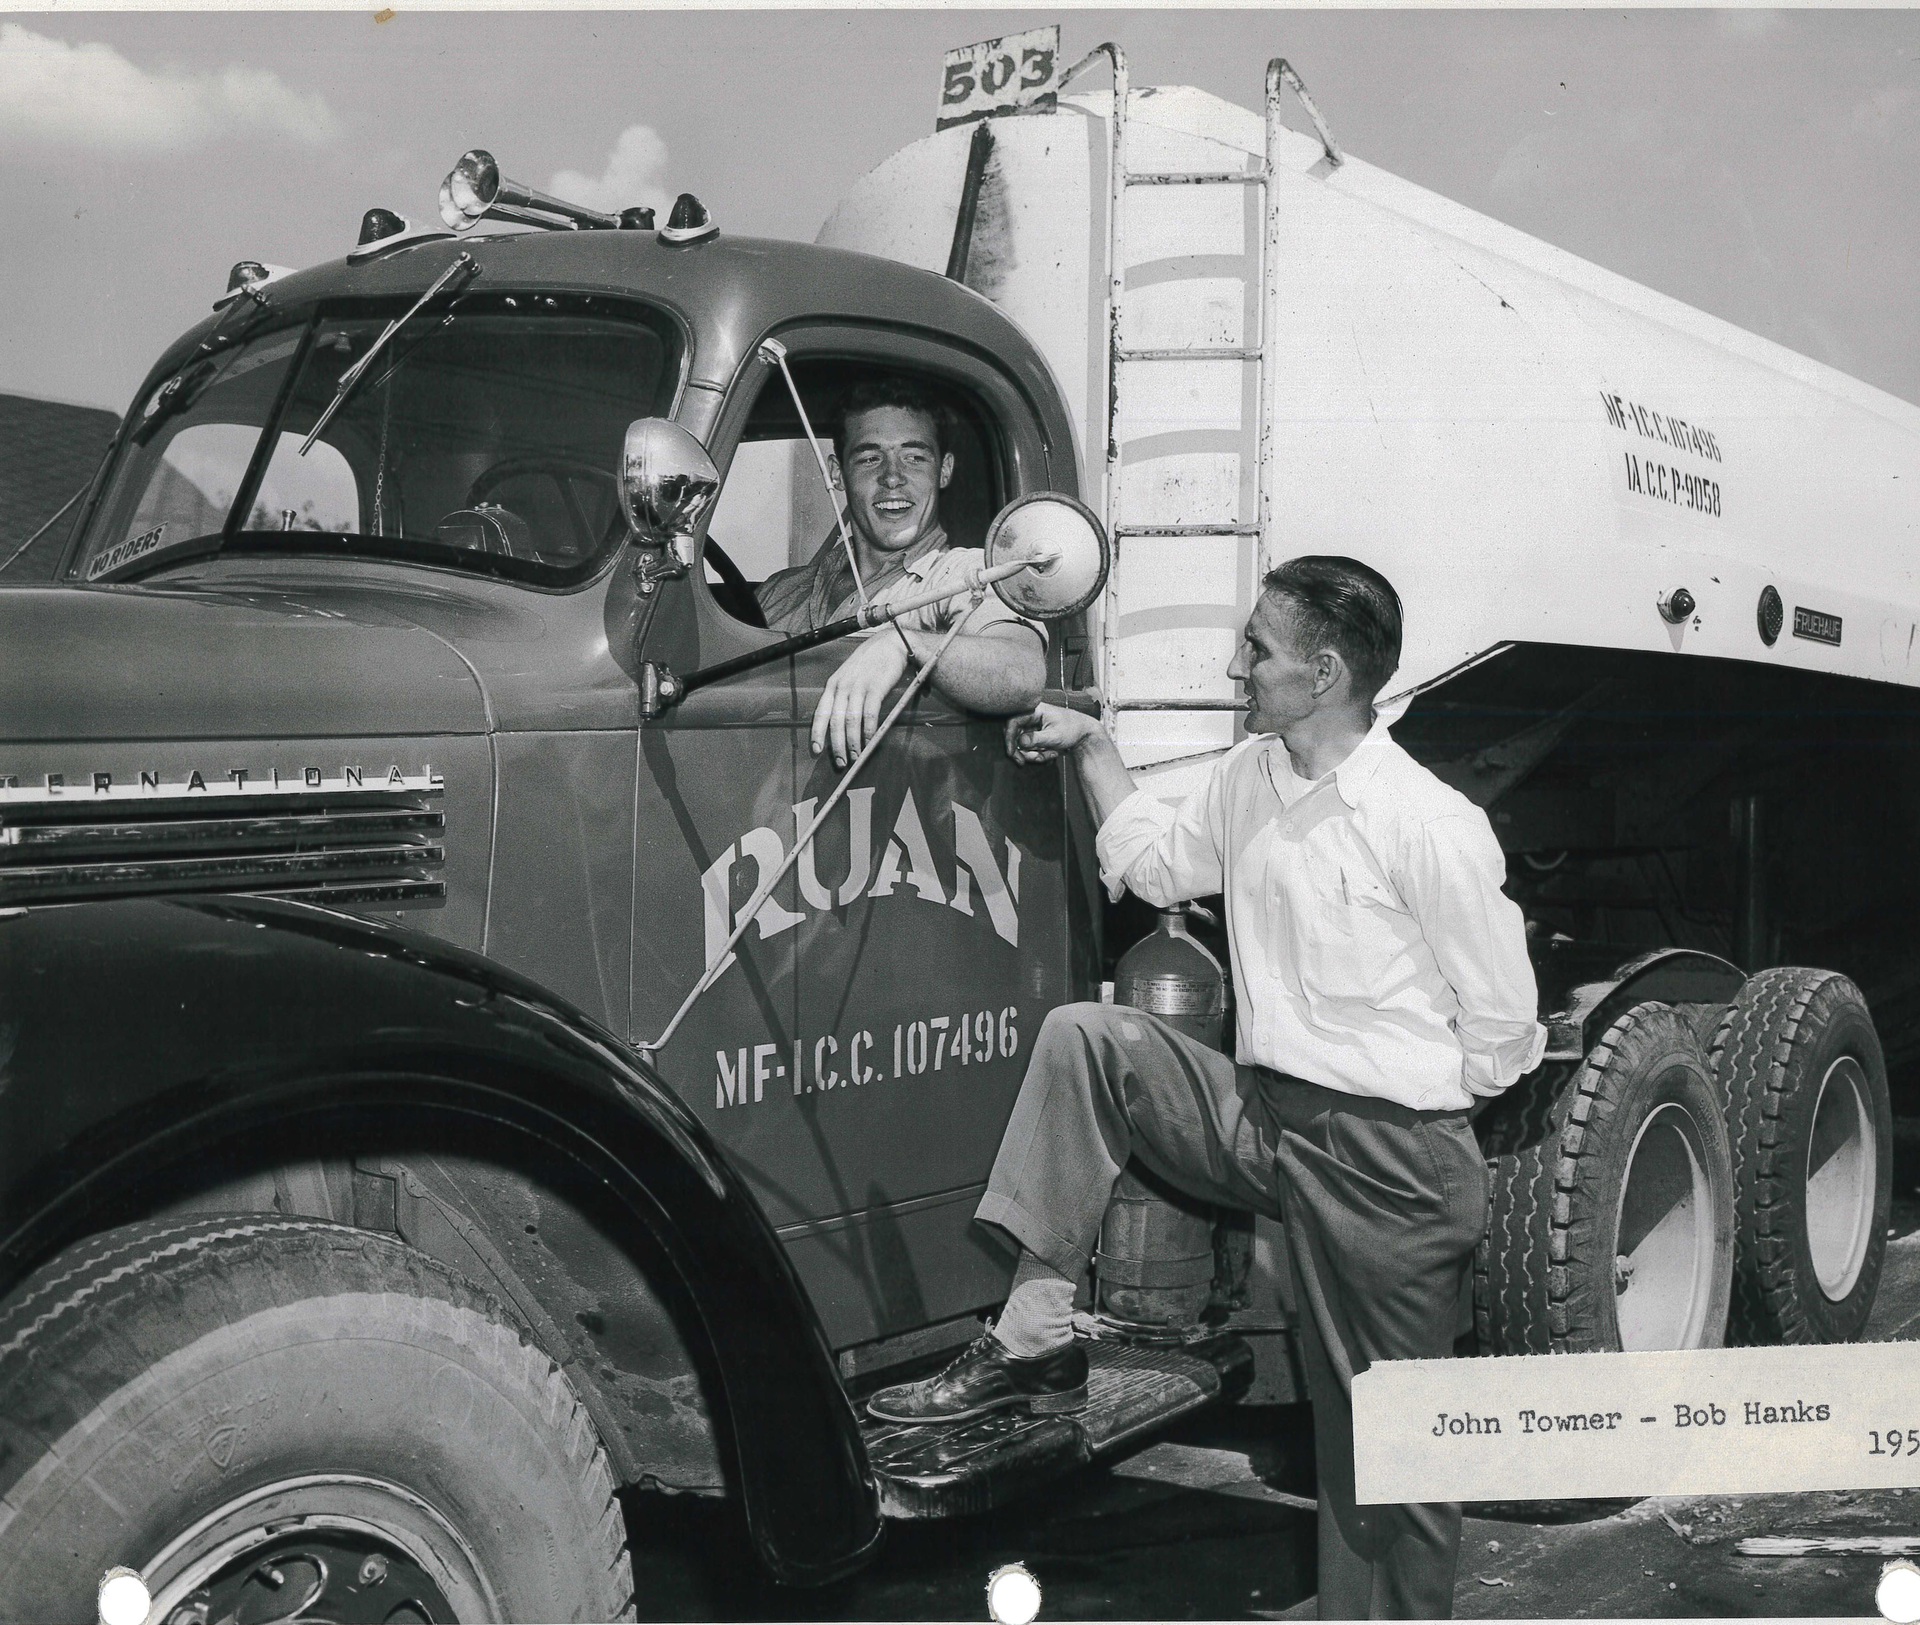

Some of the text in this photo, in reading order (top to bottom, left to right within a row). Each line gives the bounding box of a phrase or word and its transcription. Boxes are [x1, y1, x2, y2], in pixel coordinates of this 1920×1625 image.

[942, 47, 1055, 106] 503
[89, 527, 163, 577] NO RIDERS
[1795, 610, 1842, 638] FRUEHAUF
[701, 786, 1022, 993] RUAN
[893, 1005, 1019, 1079] 107496
